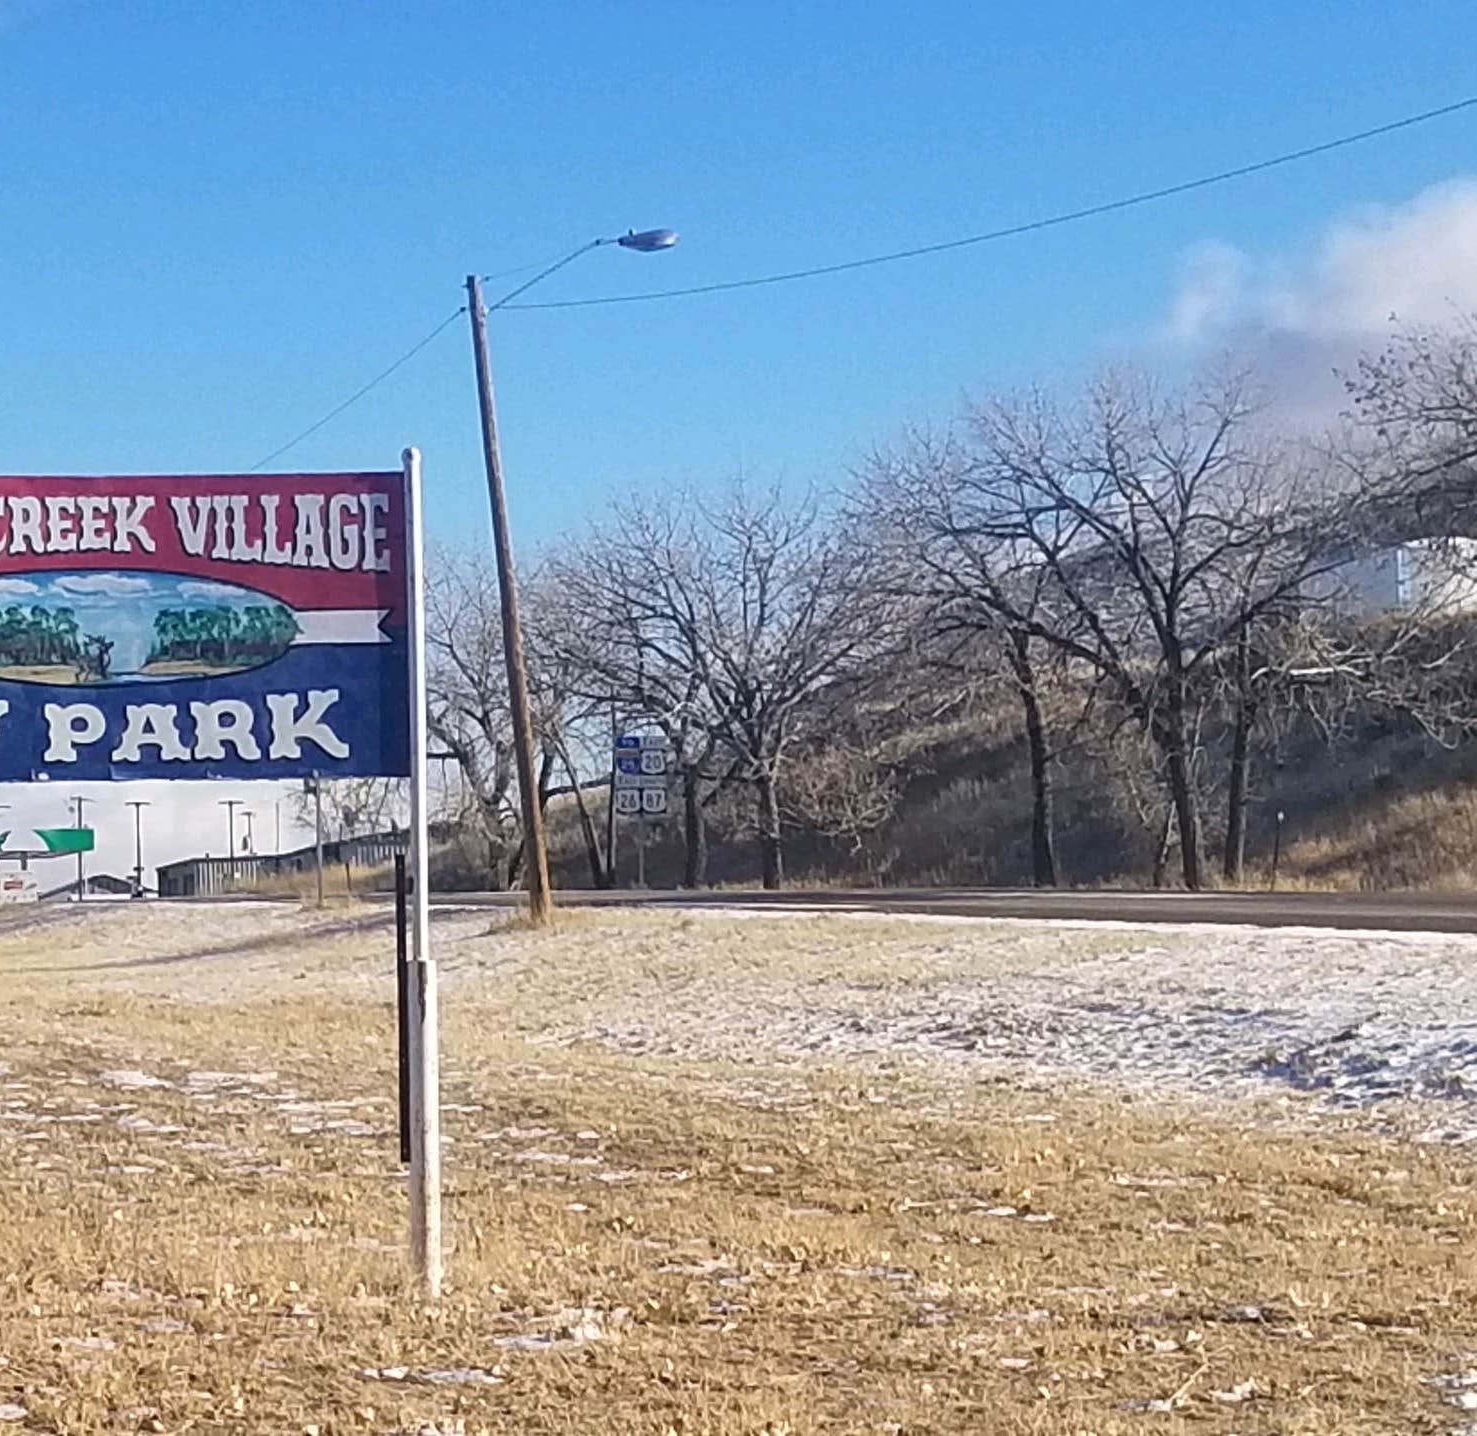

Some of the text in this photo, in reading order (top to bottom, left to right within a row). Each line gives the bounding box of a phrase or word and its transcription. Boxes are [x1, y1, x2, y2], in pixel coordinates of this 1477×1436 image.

[170, 493, 390, 572] VILLAGE
[43, 689, 350, 763] PARK
[645, 755, 661, 769] 20
[646, 793, 662, 808] 87
